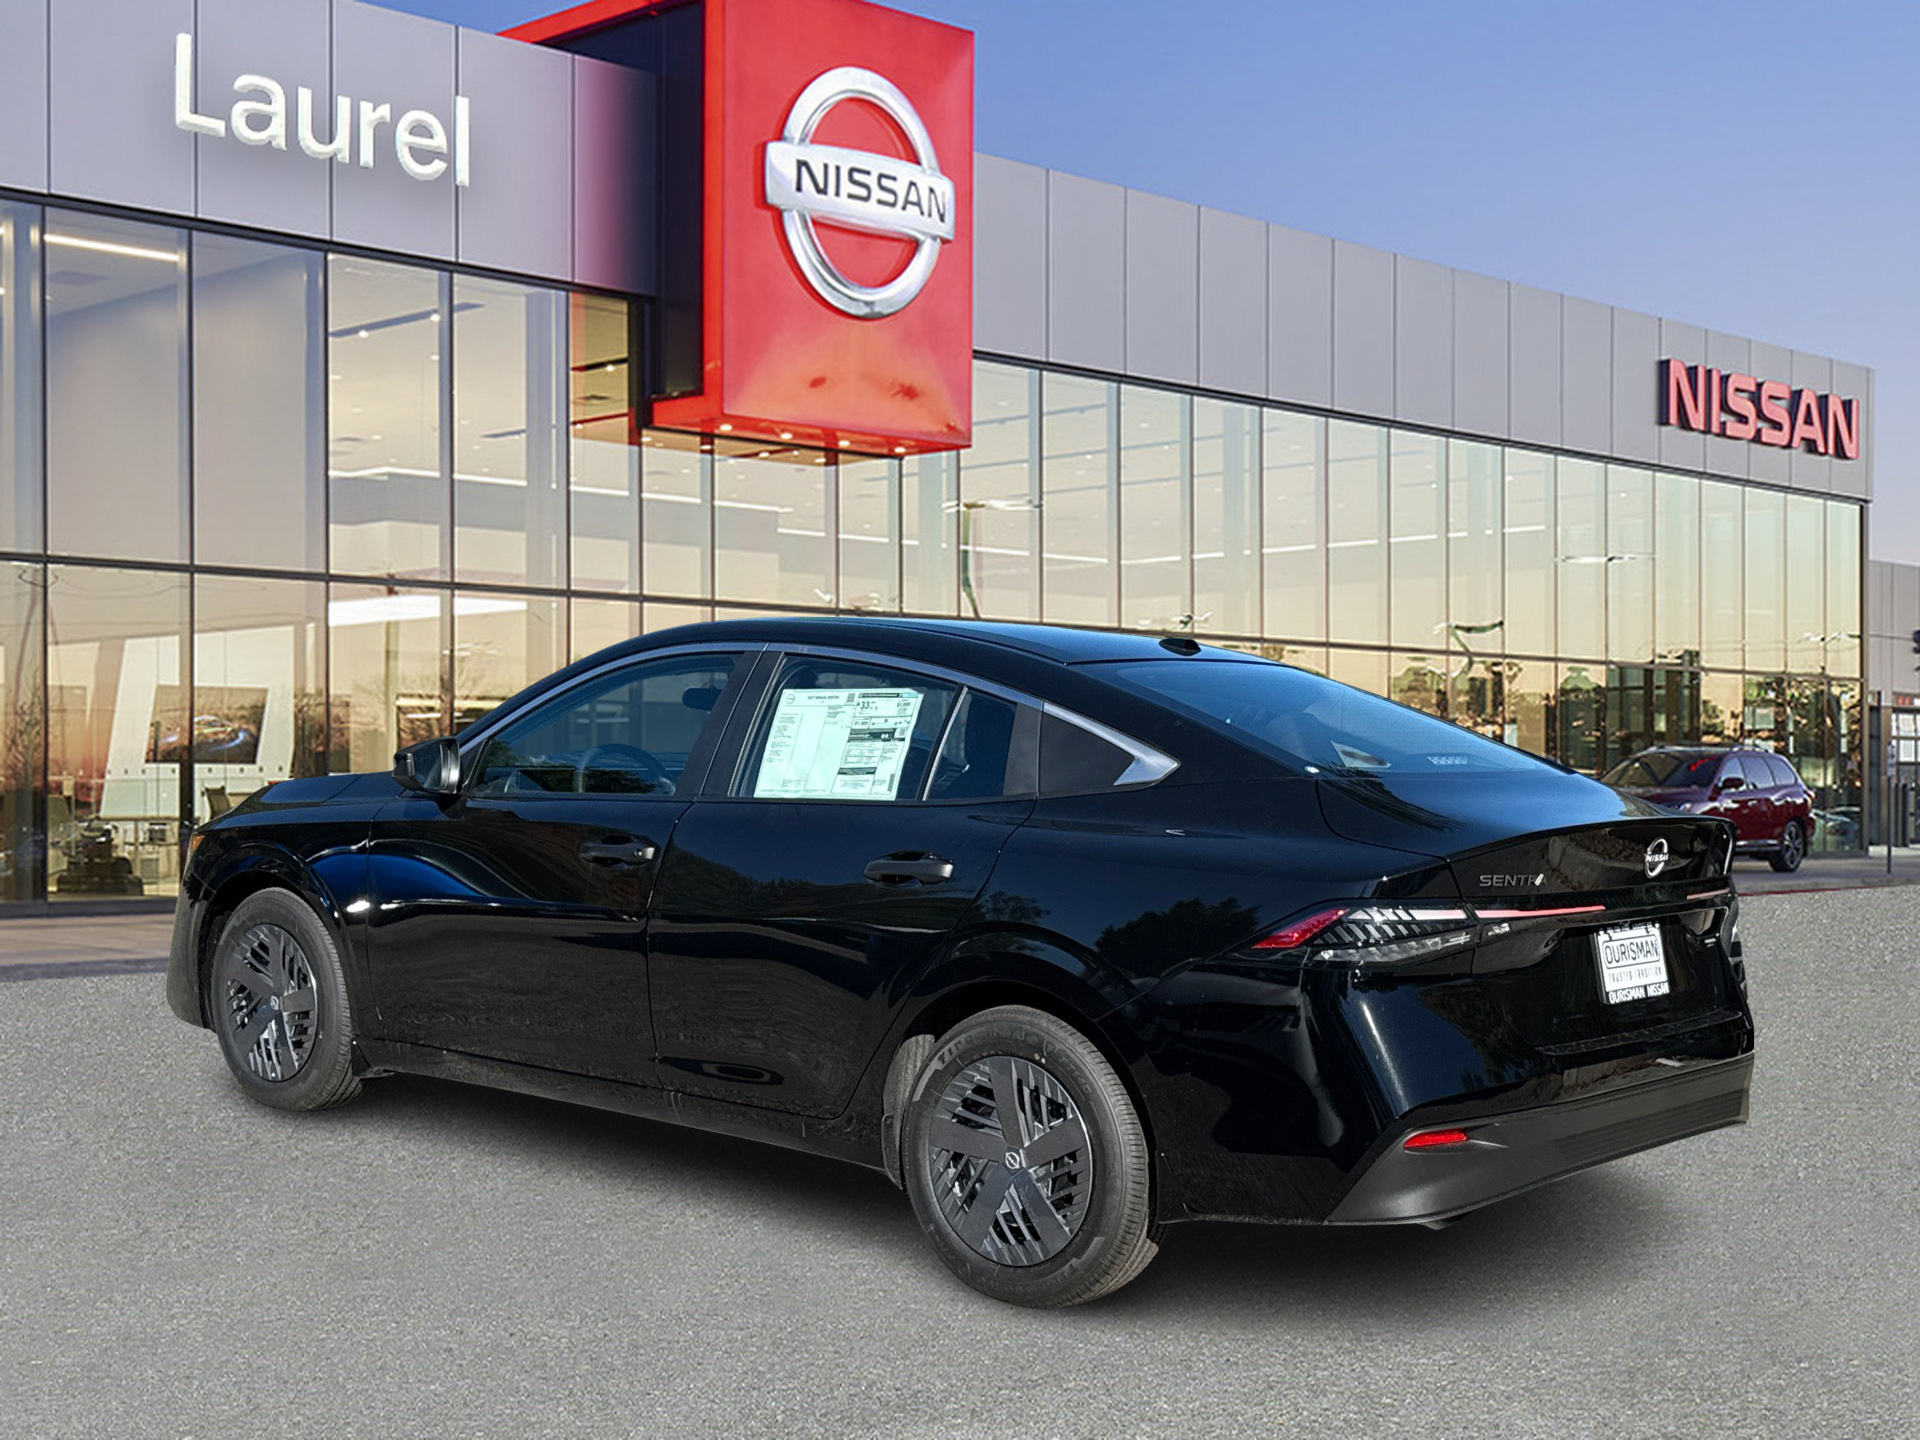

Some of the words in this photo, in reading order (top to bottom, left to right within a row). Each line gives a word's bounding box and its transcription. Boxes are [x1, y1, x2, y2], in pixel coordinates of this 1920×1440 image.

[174, 32, 470, 188] Laurel
[794, 158, 947, 224] NISSAN
[1657, 357, 1861, 461] NISSAN
[1604, 939, 1660, 965] OURISMAN
